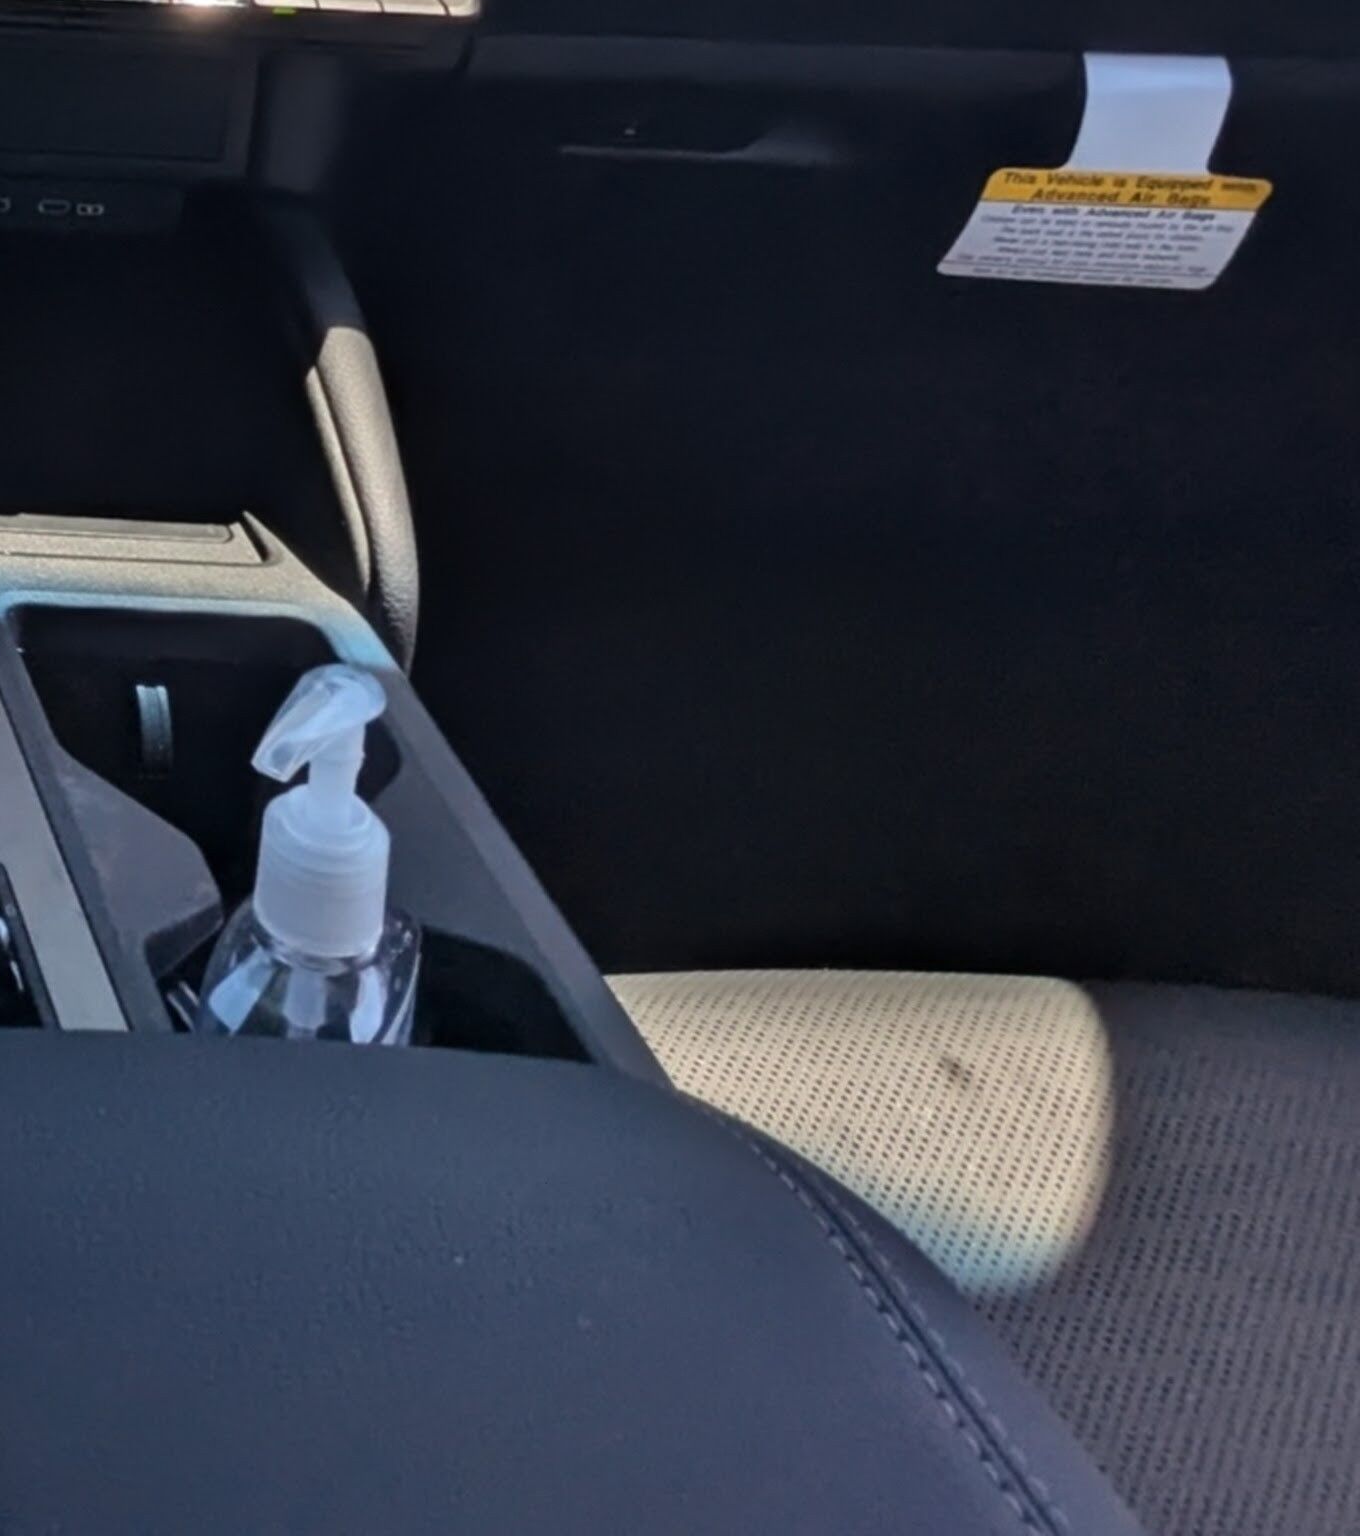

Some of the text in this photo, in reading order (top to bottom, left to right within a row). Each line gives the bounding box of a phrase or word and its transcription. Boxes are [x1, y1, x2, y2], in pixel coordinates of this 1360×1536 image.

[1004, 172, 1037, 185] This
[1047, 173, 1104, 187] Vehicle
[1136, 175, 1214, 191] Equipped
[1030, 187, 1211, 208] Advanced Air Bags
[1086, 207, 1151, 218] Advanced
